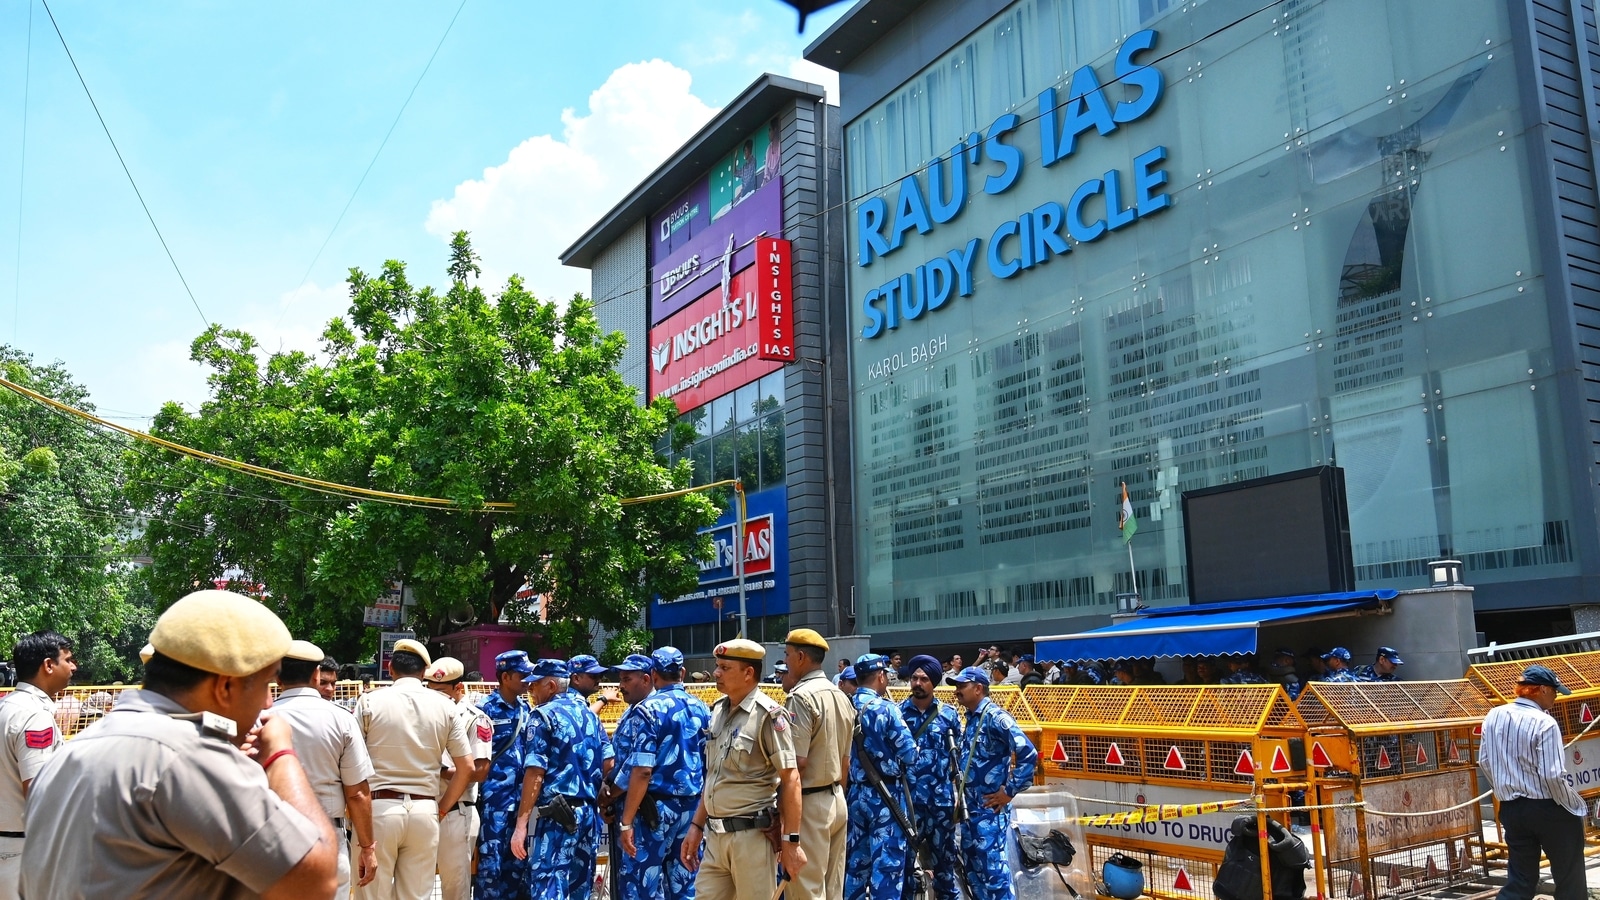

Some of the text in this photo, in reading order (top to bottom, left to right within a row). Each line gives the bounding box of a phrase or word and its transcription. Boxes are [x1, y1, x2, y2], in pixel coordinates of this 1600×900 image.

[857, 28, 1164, 267] RAU'S IAS
[862, 145, 1171, 339] STUDY CIRCLE
[769, 241, 782, 339] INSIGHTS
[673, 297, 743, 362] INSIGHTS
[764, 343, 791, 356] IAS
[868, 333, 947, 380] KAROL BAGH
[737, 528, 770, 563] AS
[1576, 770, 1591, 786] NO
[1592, 768, 1600, 782] T
[1136, 821, 1157, 835] NO
[1161, 821, 1184, 838] TO
[1189, 824, 1234, 844] DRUG
